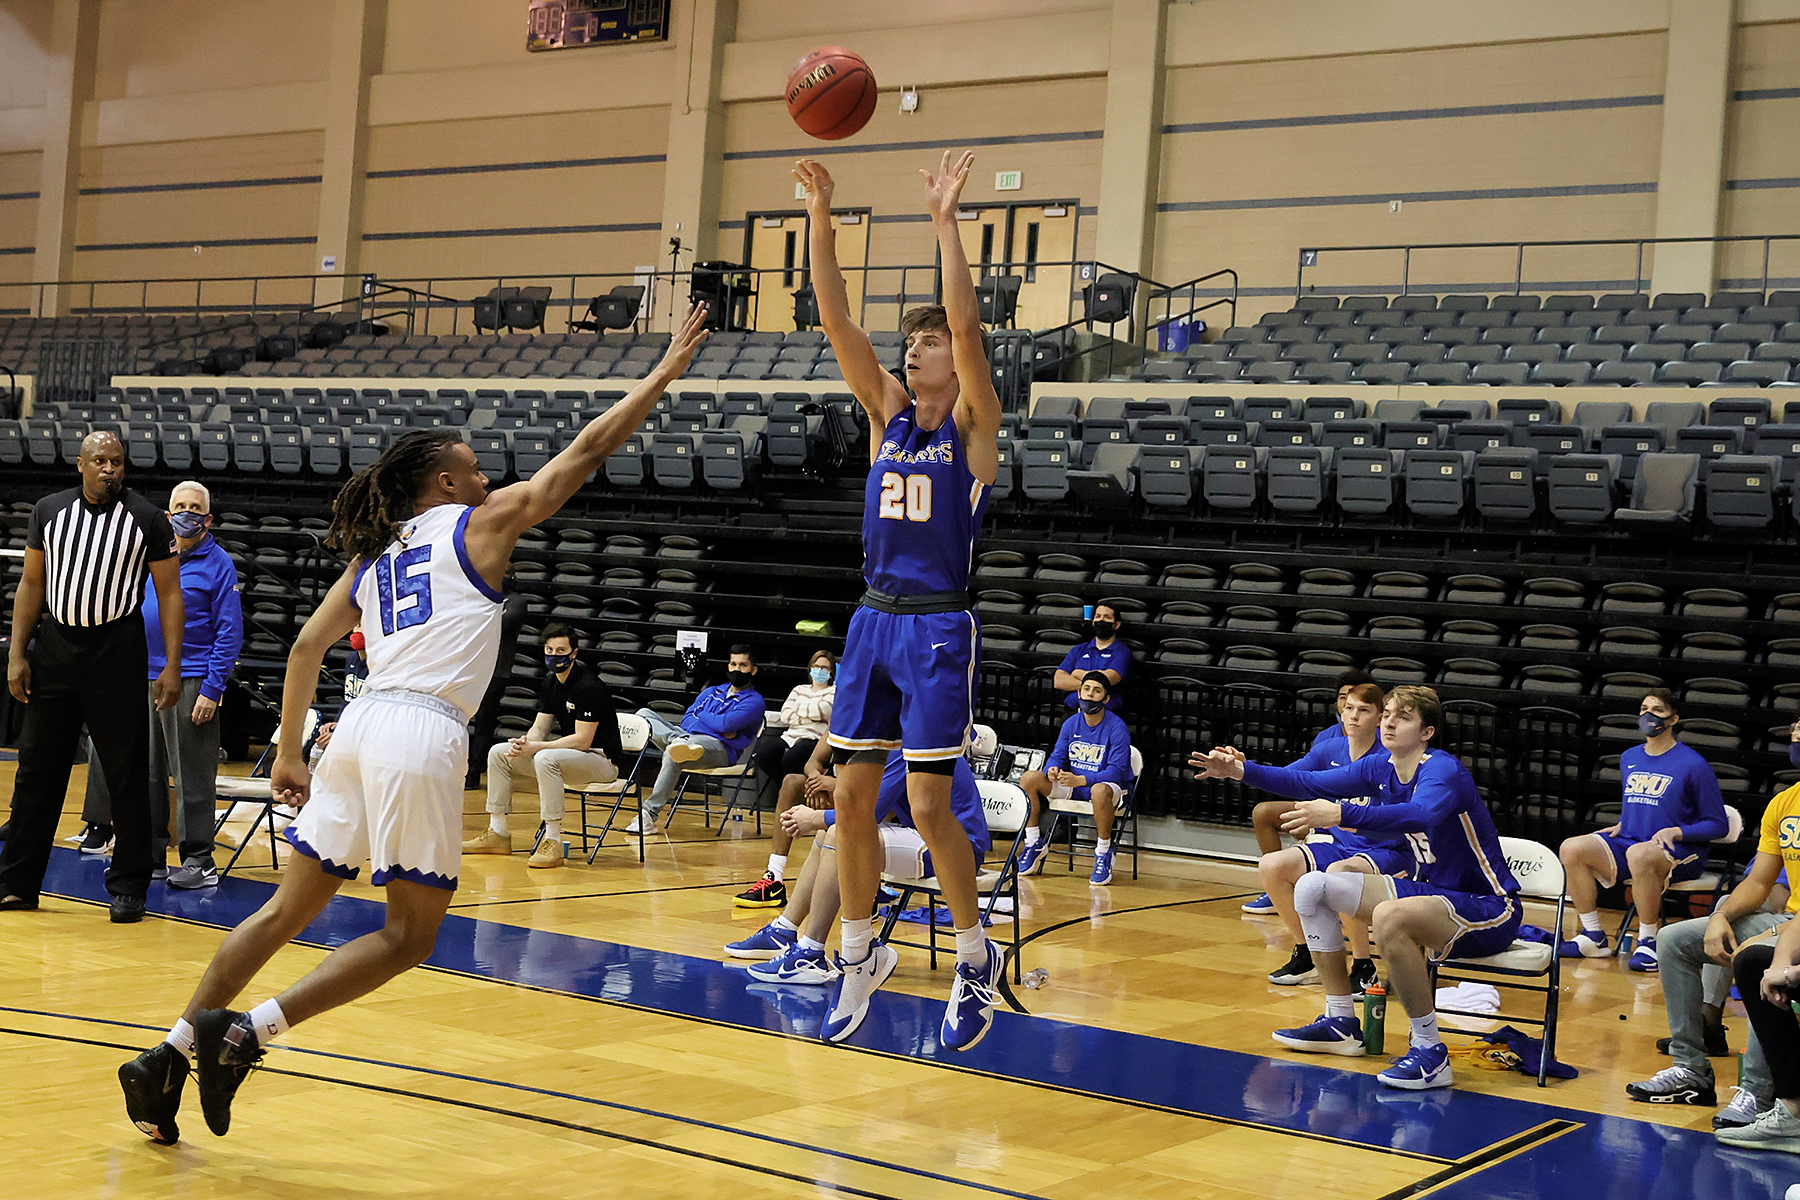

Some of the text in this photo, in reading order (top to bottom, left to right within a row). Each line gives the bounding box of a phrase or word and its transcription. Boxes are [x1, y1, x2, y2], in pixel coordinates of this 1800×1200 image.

[1000, 173, 1017, 188] EXIT
[1306, 253, 1315, 265] 7
[1081, 266, 1090, 279] 6
[879, 472, 933, 522] 20
[375, 544, 433, 637] 15
[405, 692, 459, 717] UNDER
[1371, 1004, 1384, 1020] G
